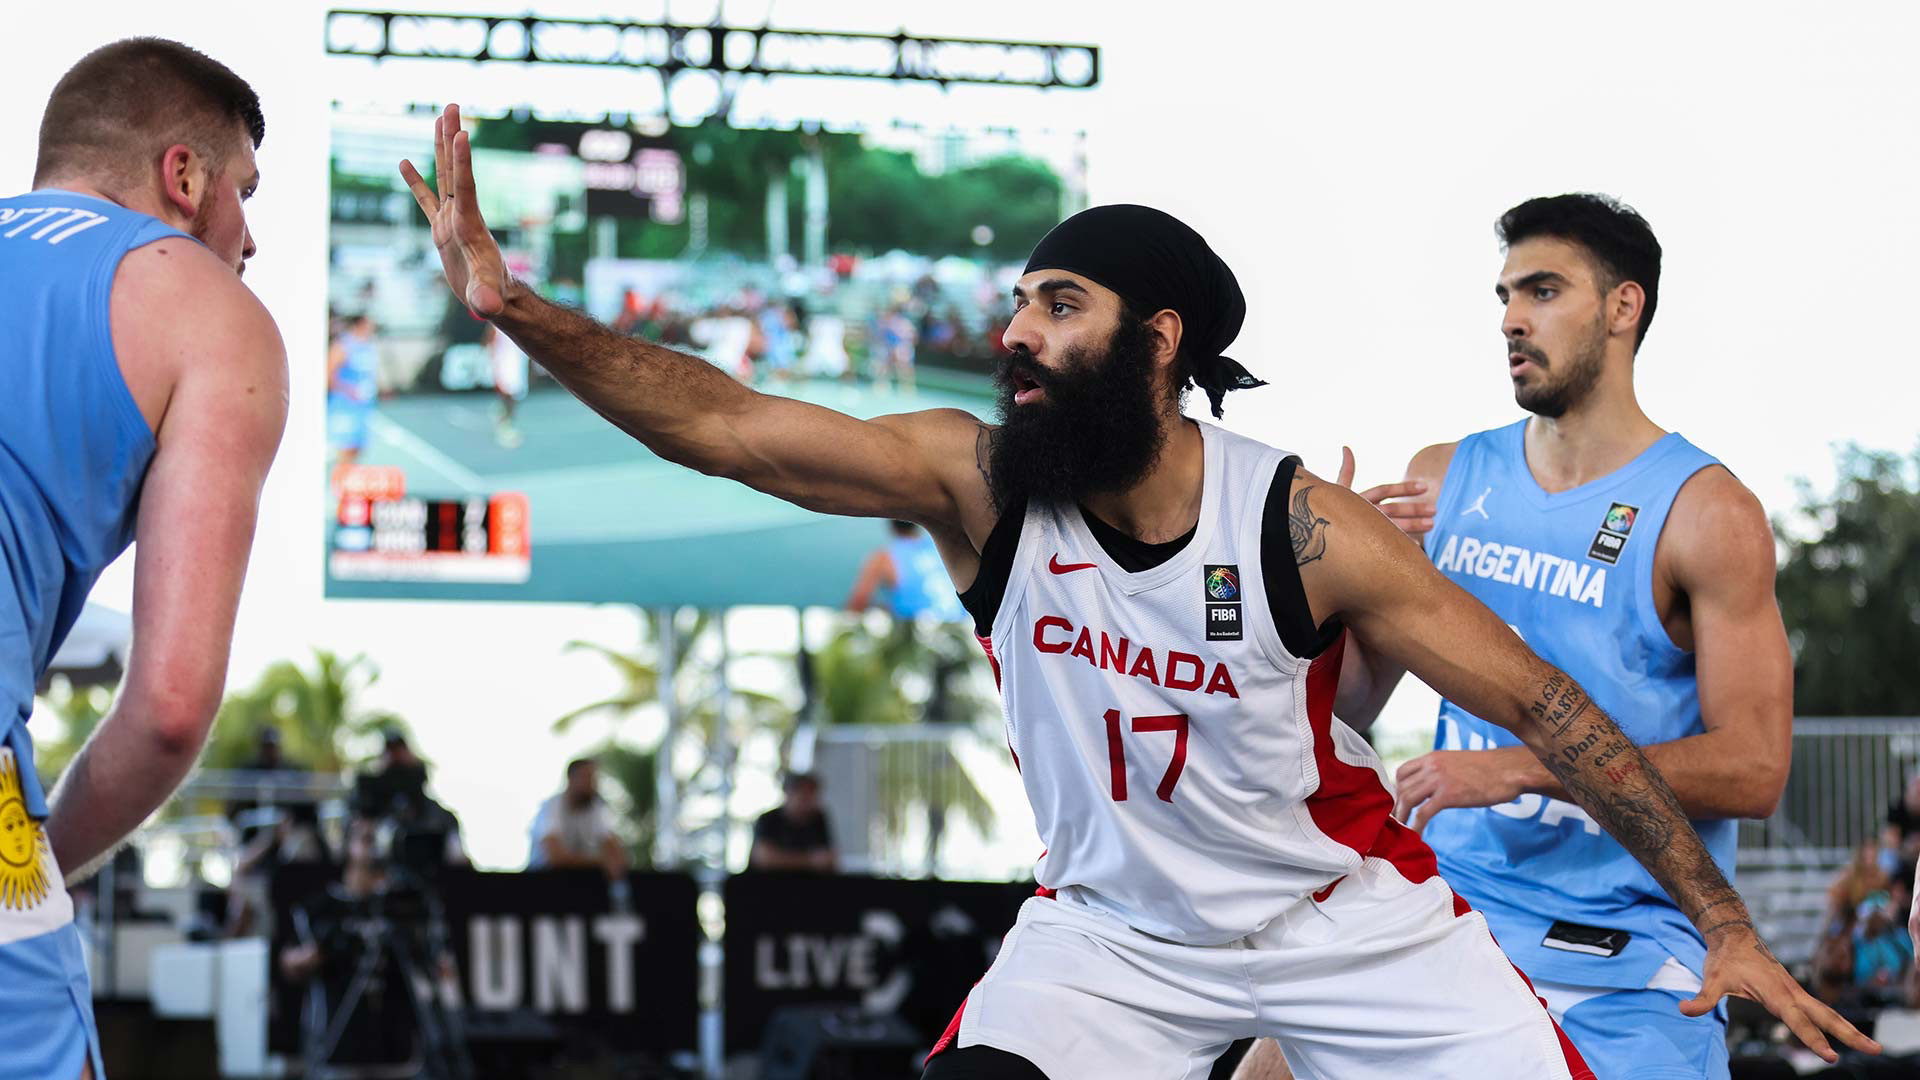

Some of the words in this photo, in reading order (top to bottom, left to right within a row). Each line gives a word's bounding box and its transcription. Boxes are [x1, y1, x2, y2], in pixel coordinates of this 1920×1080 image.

[1598, 533, 1622, 549] FIBA
[1437, 535, 1607, 608] ARGENTINA
[1211, 608, 1237, 621] FIBA
[1033, 615, 1240, 699] CANADA
[1103, 708, 1189, 804] 17
[1563, 724, 1608, 763] Don't
[755, 934, 877, 989] LIVE
